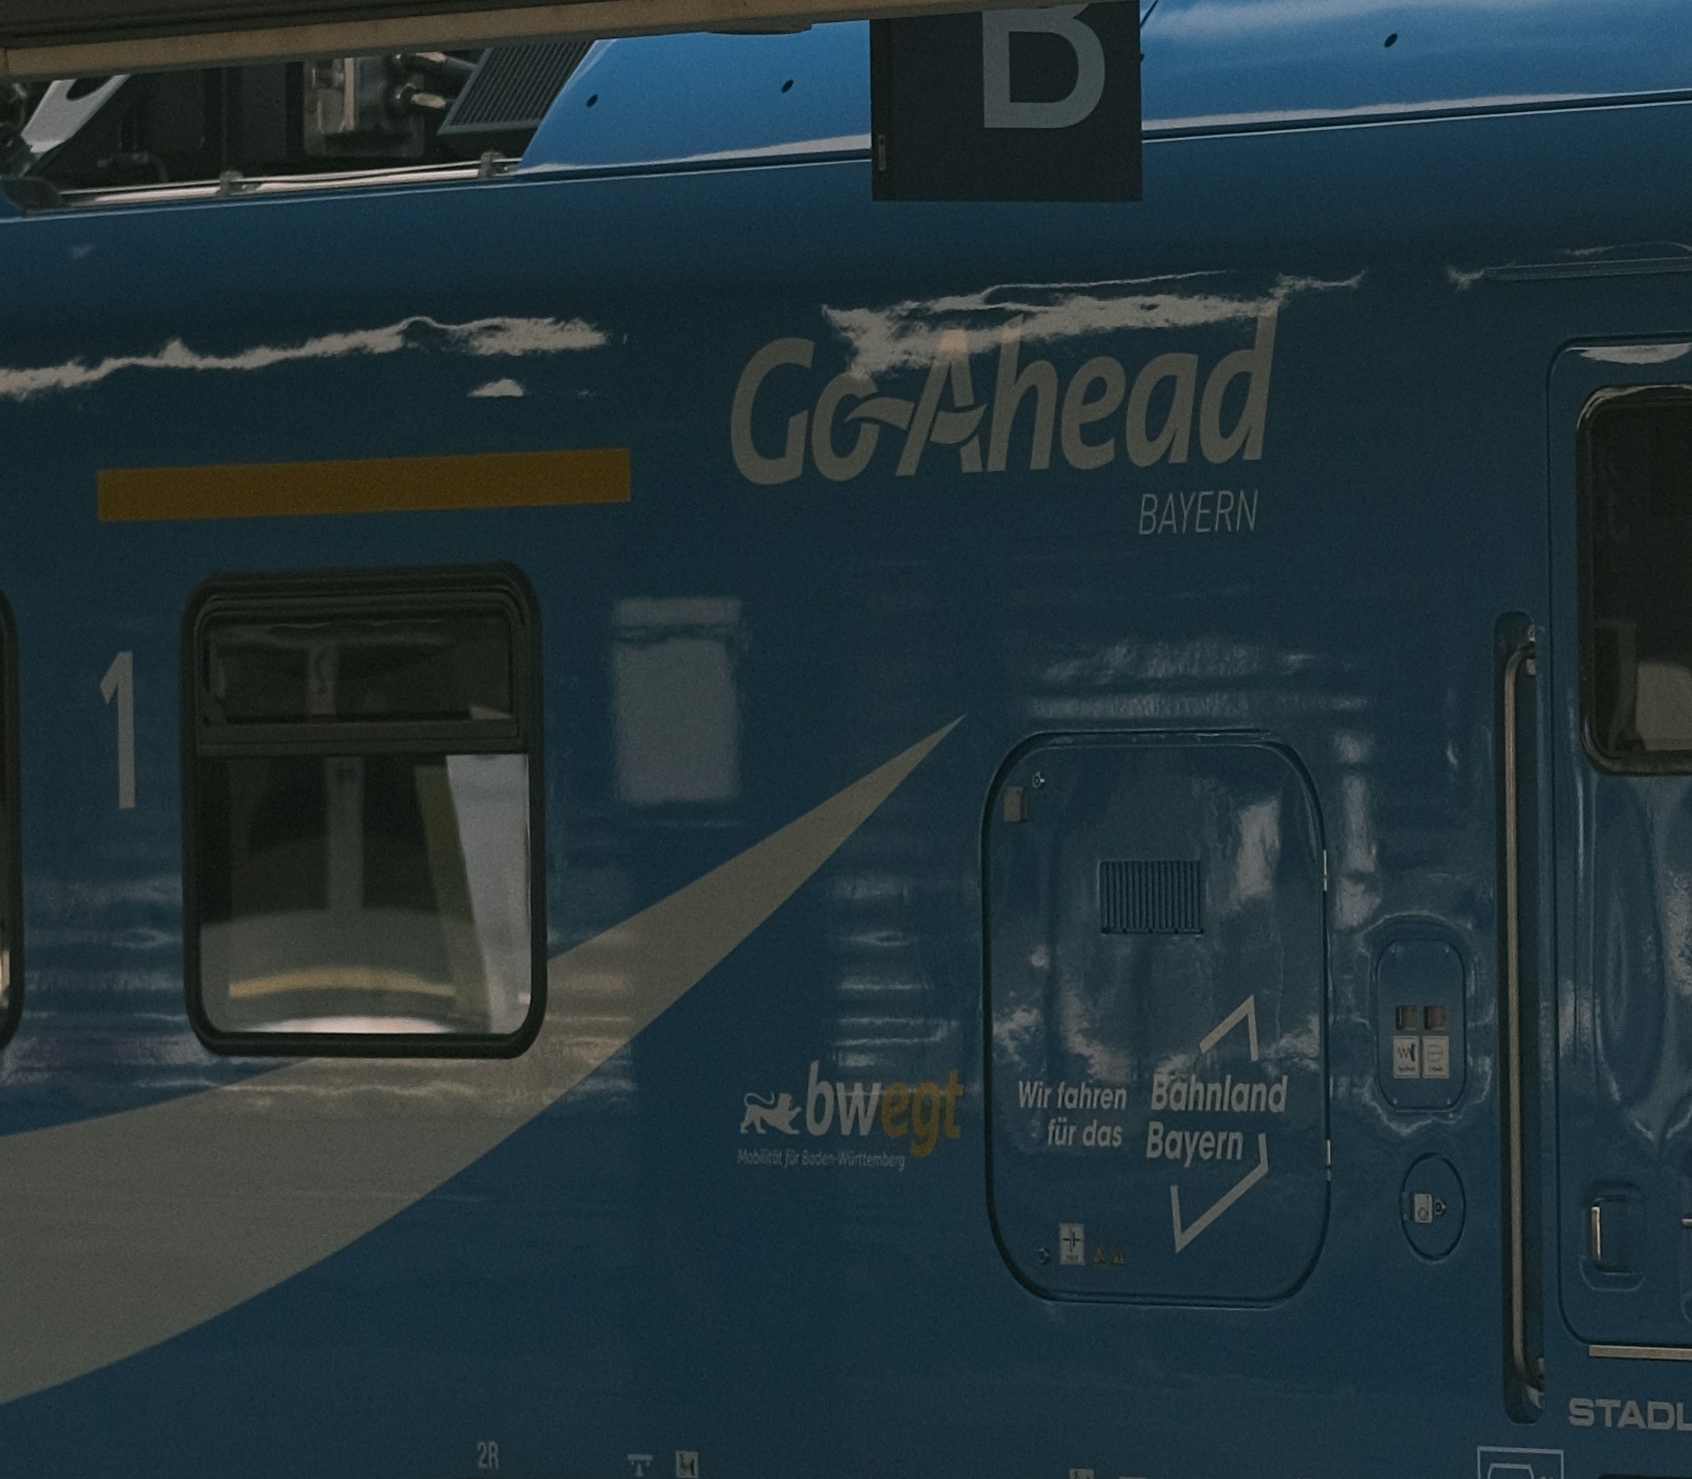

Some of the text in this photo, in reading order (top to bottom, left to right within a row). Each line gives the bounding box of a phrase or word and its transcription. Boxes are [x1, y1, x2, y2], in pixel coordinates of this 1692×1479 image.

[982, 3, 1106, 129] B
[1138, 489, 1260, 536] BAYERN
[100, 650, 135, 809] 1
[806, 1059, 965, 1158] bwegt
[1018, 1080, 1128, 1110] Wir fahren
[1151, 1073, 1289, 1114] Bahnland
[1047, 1117, 1124, 1149] für das
[1145, 1121, 1244, 1169] Bayern
[784, 1148, 800, 1169] für
